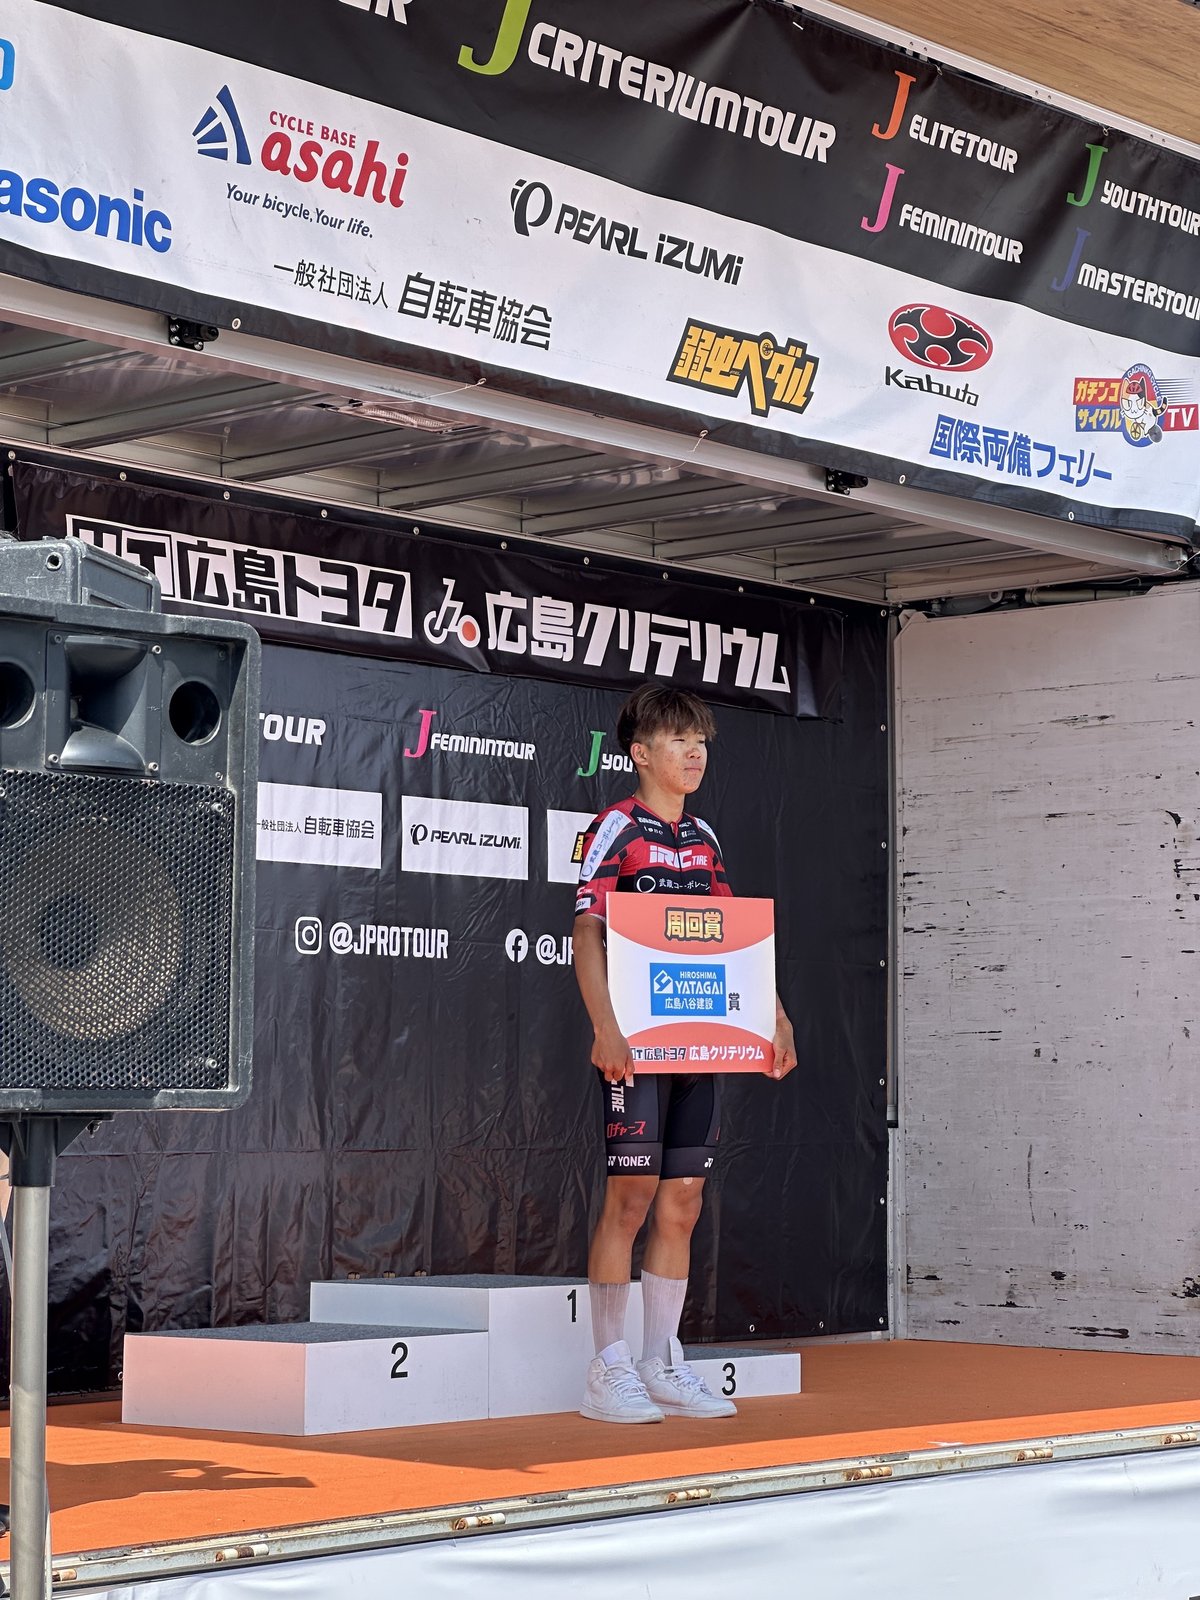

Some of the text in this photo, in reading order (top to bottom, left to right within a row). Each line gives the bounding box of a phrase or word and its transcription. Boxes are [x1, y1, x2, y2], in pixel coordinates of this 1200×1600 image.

[528, 22, 836, 163] CRITERIUMTOUR
[269, 110, 356, 149] CYCLE BASE
[871, 70, 1018, 173] J ELITETOUR
[260, 140, 409, 208] asahi
[1066, 143, 1200, 236] J YOUTHTOUR
[226, 182, 260, 205] Your
[346, 218, 373, 238] life.
[860, 163, 1023, 263] J FEMININTOUR
[555, 205, 648, 261] PEARL
[273, 259, 552, 351] 一般社団法人 自転車協会
[669, 321, 818, 414] 弱虫ペダル
[885, 366, 979, 407] Kabuto
[1075, 381, 1121, 403] ガチンコ
[1077, 408, 1121, 429] サイクル
[1167, 407, 1195, 428] TV
[929, 414, 1112, 487] 国際両備フェリー
[485, 591, 791, 693] 広島クリテリウム
[404, 709, 536, 760] J FEMININTOUR
[577, 730, 637, 777] J YOU
[304, 816, 375, 840] 自転車協会
[430, 830, 477, 846] PEARL
[691, 855, 708, 866] TIRE
[329, 921, 449, 959] @JPROTOUR
[665, 908, 724, 942] 周回賞
[675, 981, 723, 994] YATAGAI
[680, 971, 717, 979] HIROSHIMA
[665, 997, 713, 1009] 広島八谷建設
[728, 992, 740, 1011] 賞
[689, 1046, 764, 1061] 広島クリテリウム
[611, 1085, 625, 1113] TIRE
[617, 1155, 651, 1167] YONEX
[566, 1289, 577, 1323] 1
[390, 1342, 409, 1379] 2
[721, 1362, 736, 1396] 3
